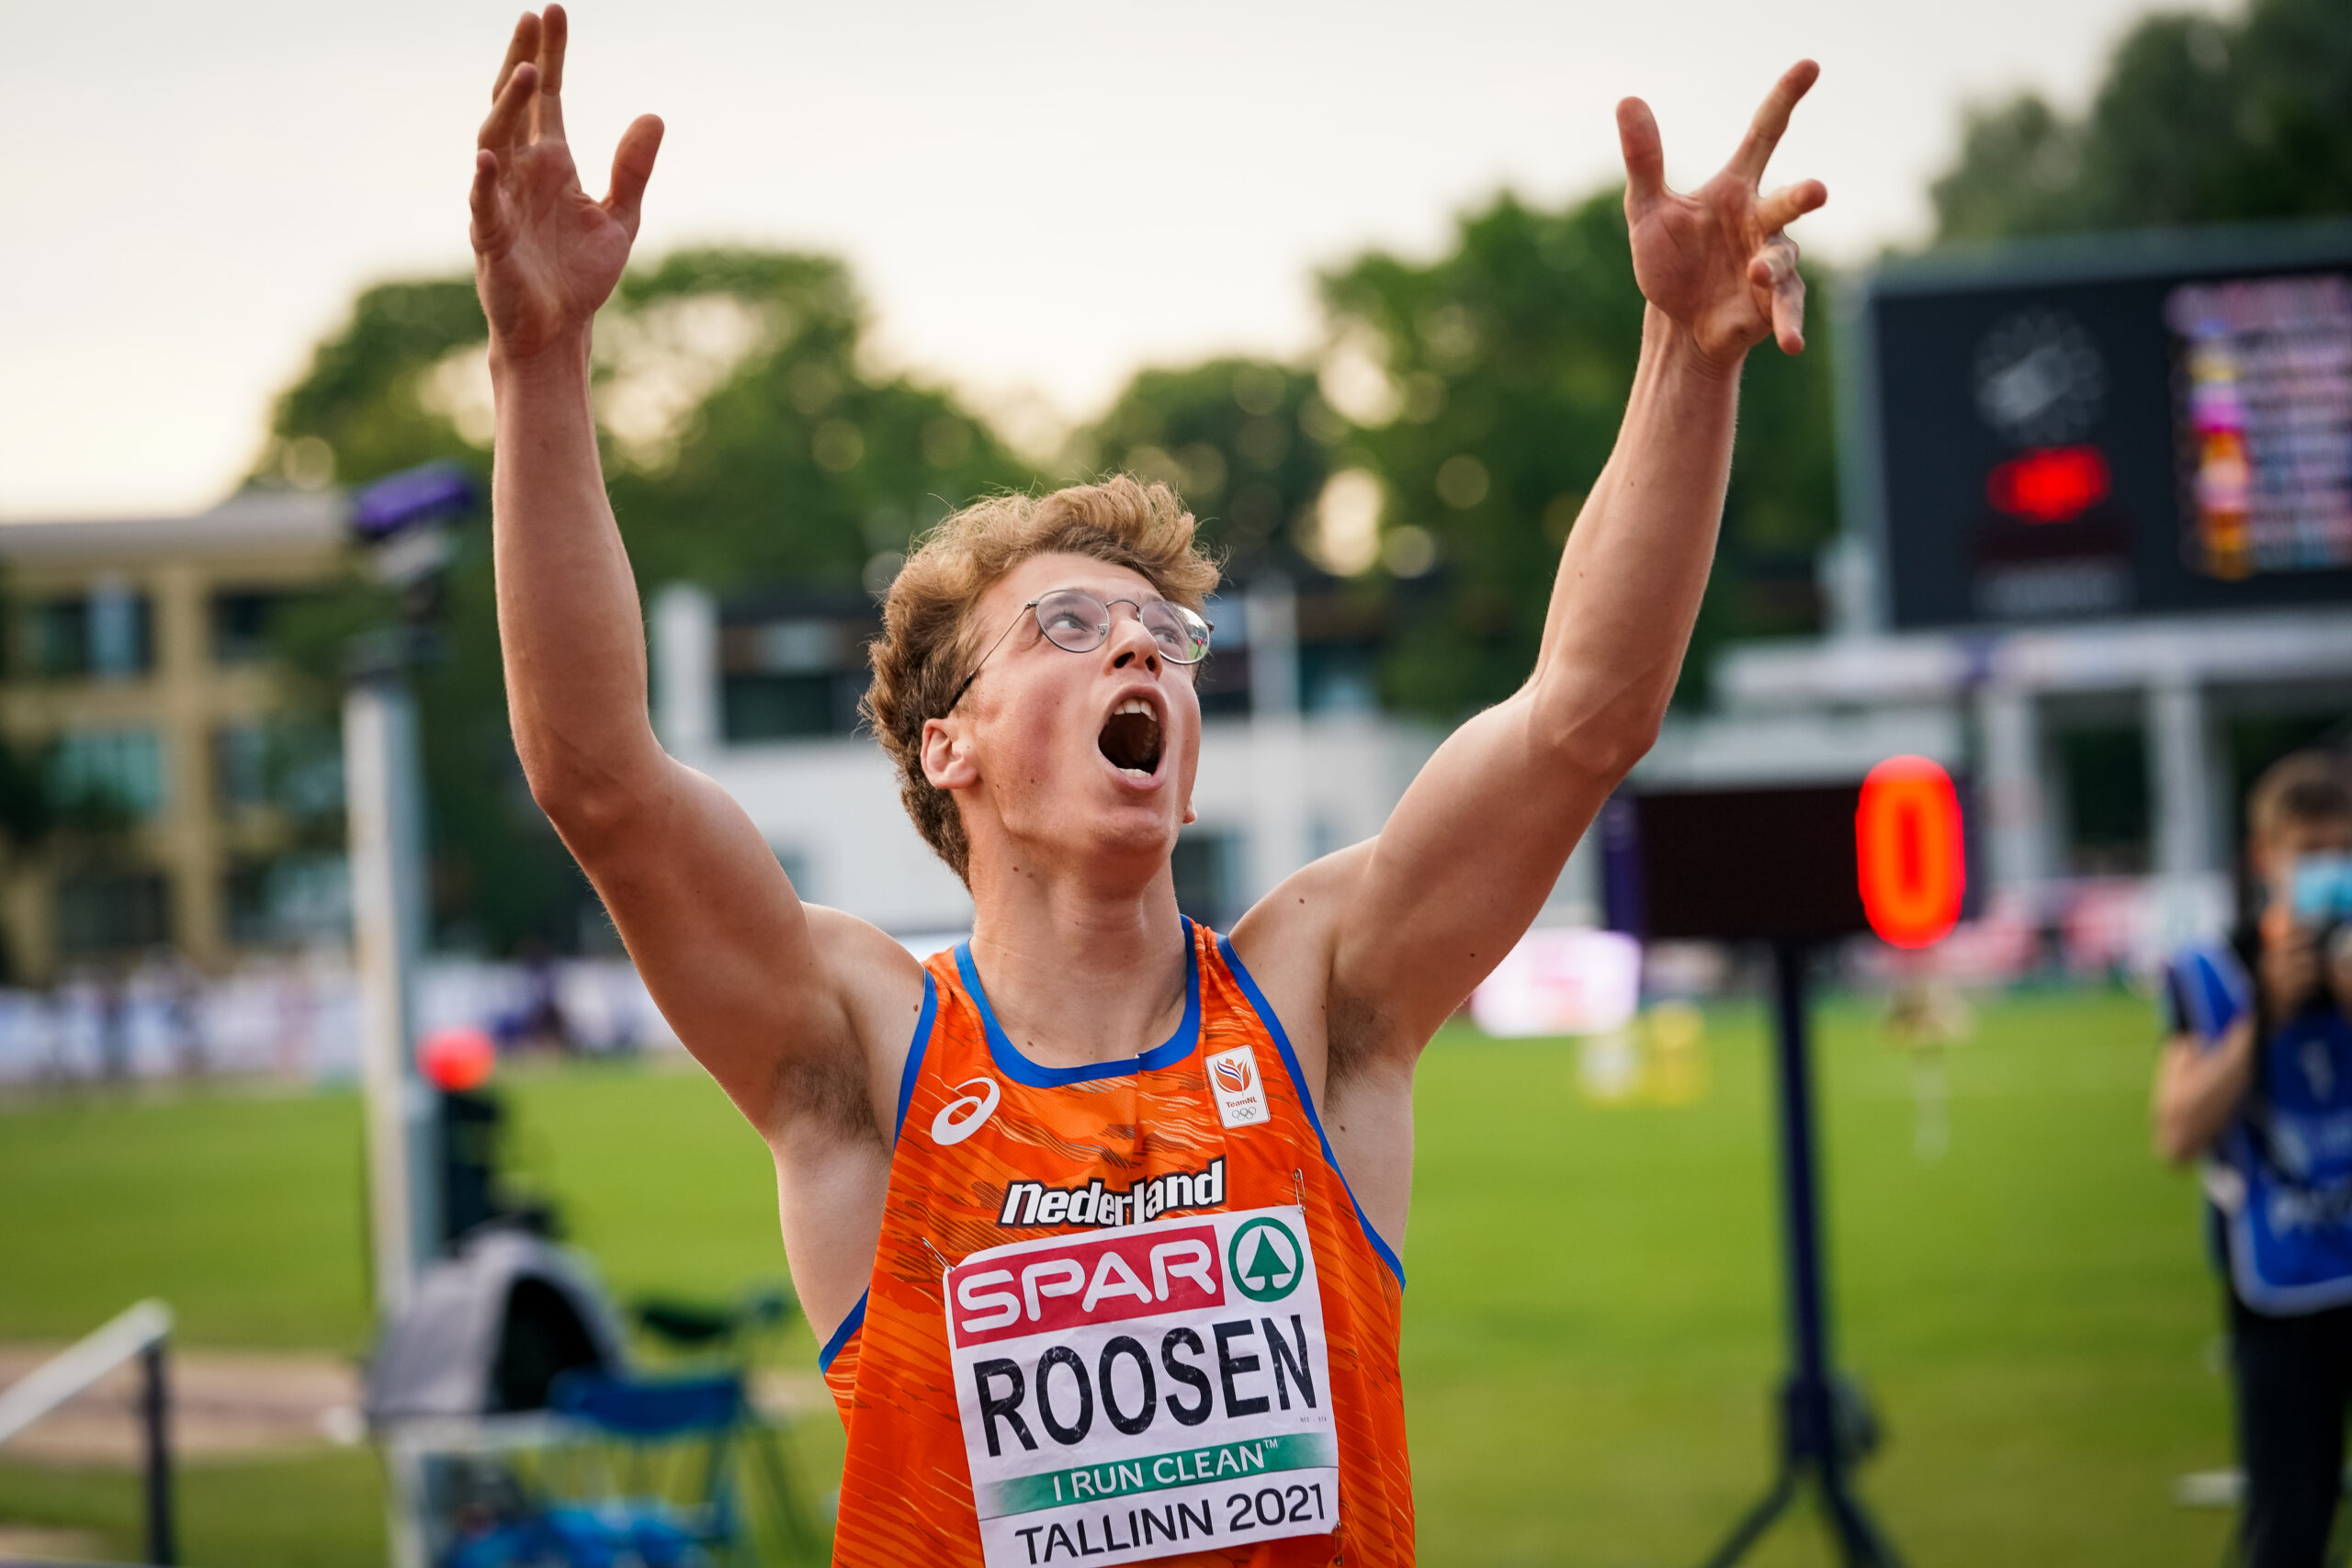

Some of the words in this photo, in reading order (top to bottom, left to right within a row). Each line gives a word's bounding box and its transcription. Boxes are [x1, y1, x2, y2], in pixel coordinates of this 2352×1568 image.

[1856, 755, 1965, 949] 0
[1226, 1096, 1257, 1108] TeamNL
[1000, 1157, 1225, 1227] Nederland
[957, 1240, 1216, 1333] SPAR
[973, 1314, 1317, 1457] ROOSEN
[1053, 1475, 1062, 1501] I
[1070, 1462, 1144, 1498] RUN
[1014, 1499, 1214, 1565] TALLINN
[1226, 1483, 1325, 1532] 2021
